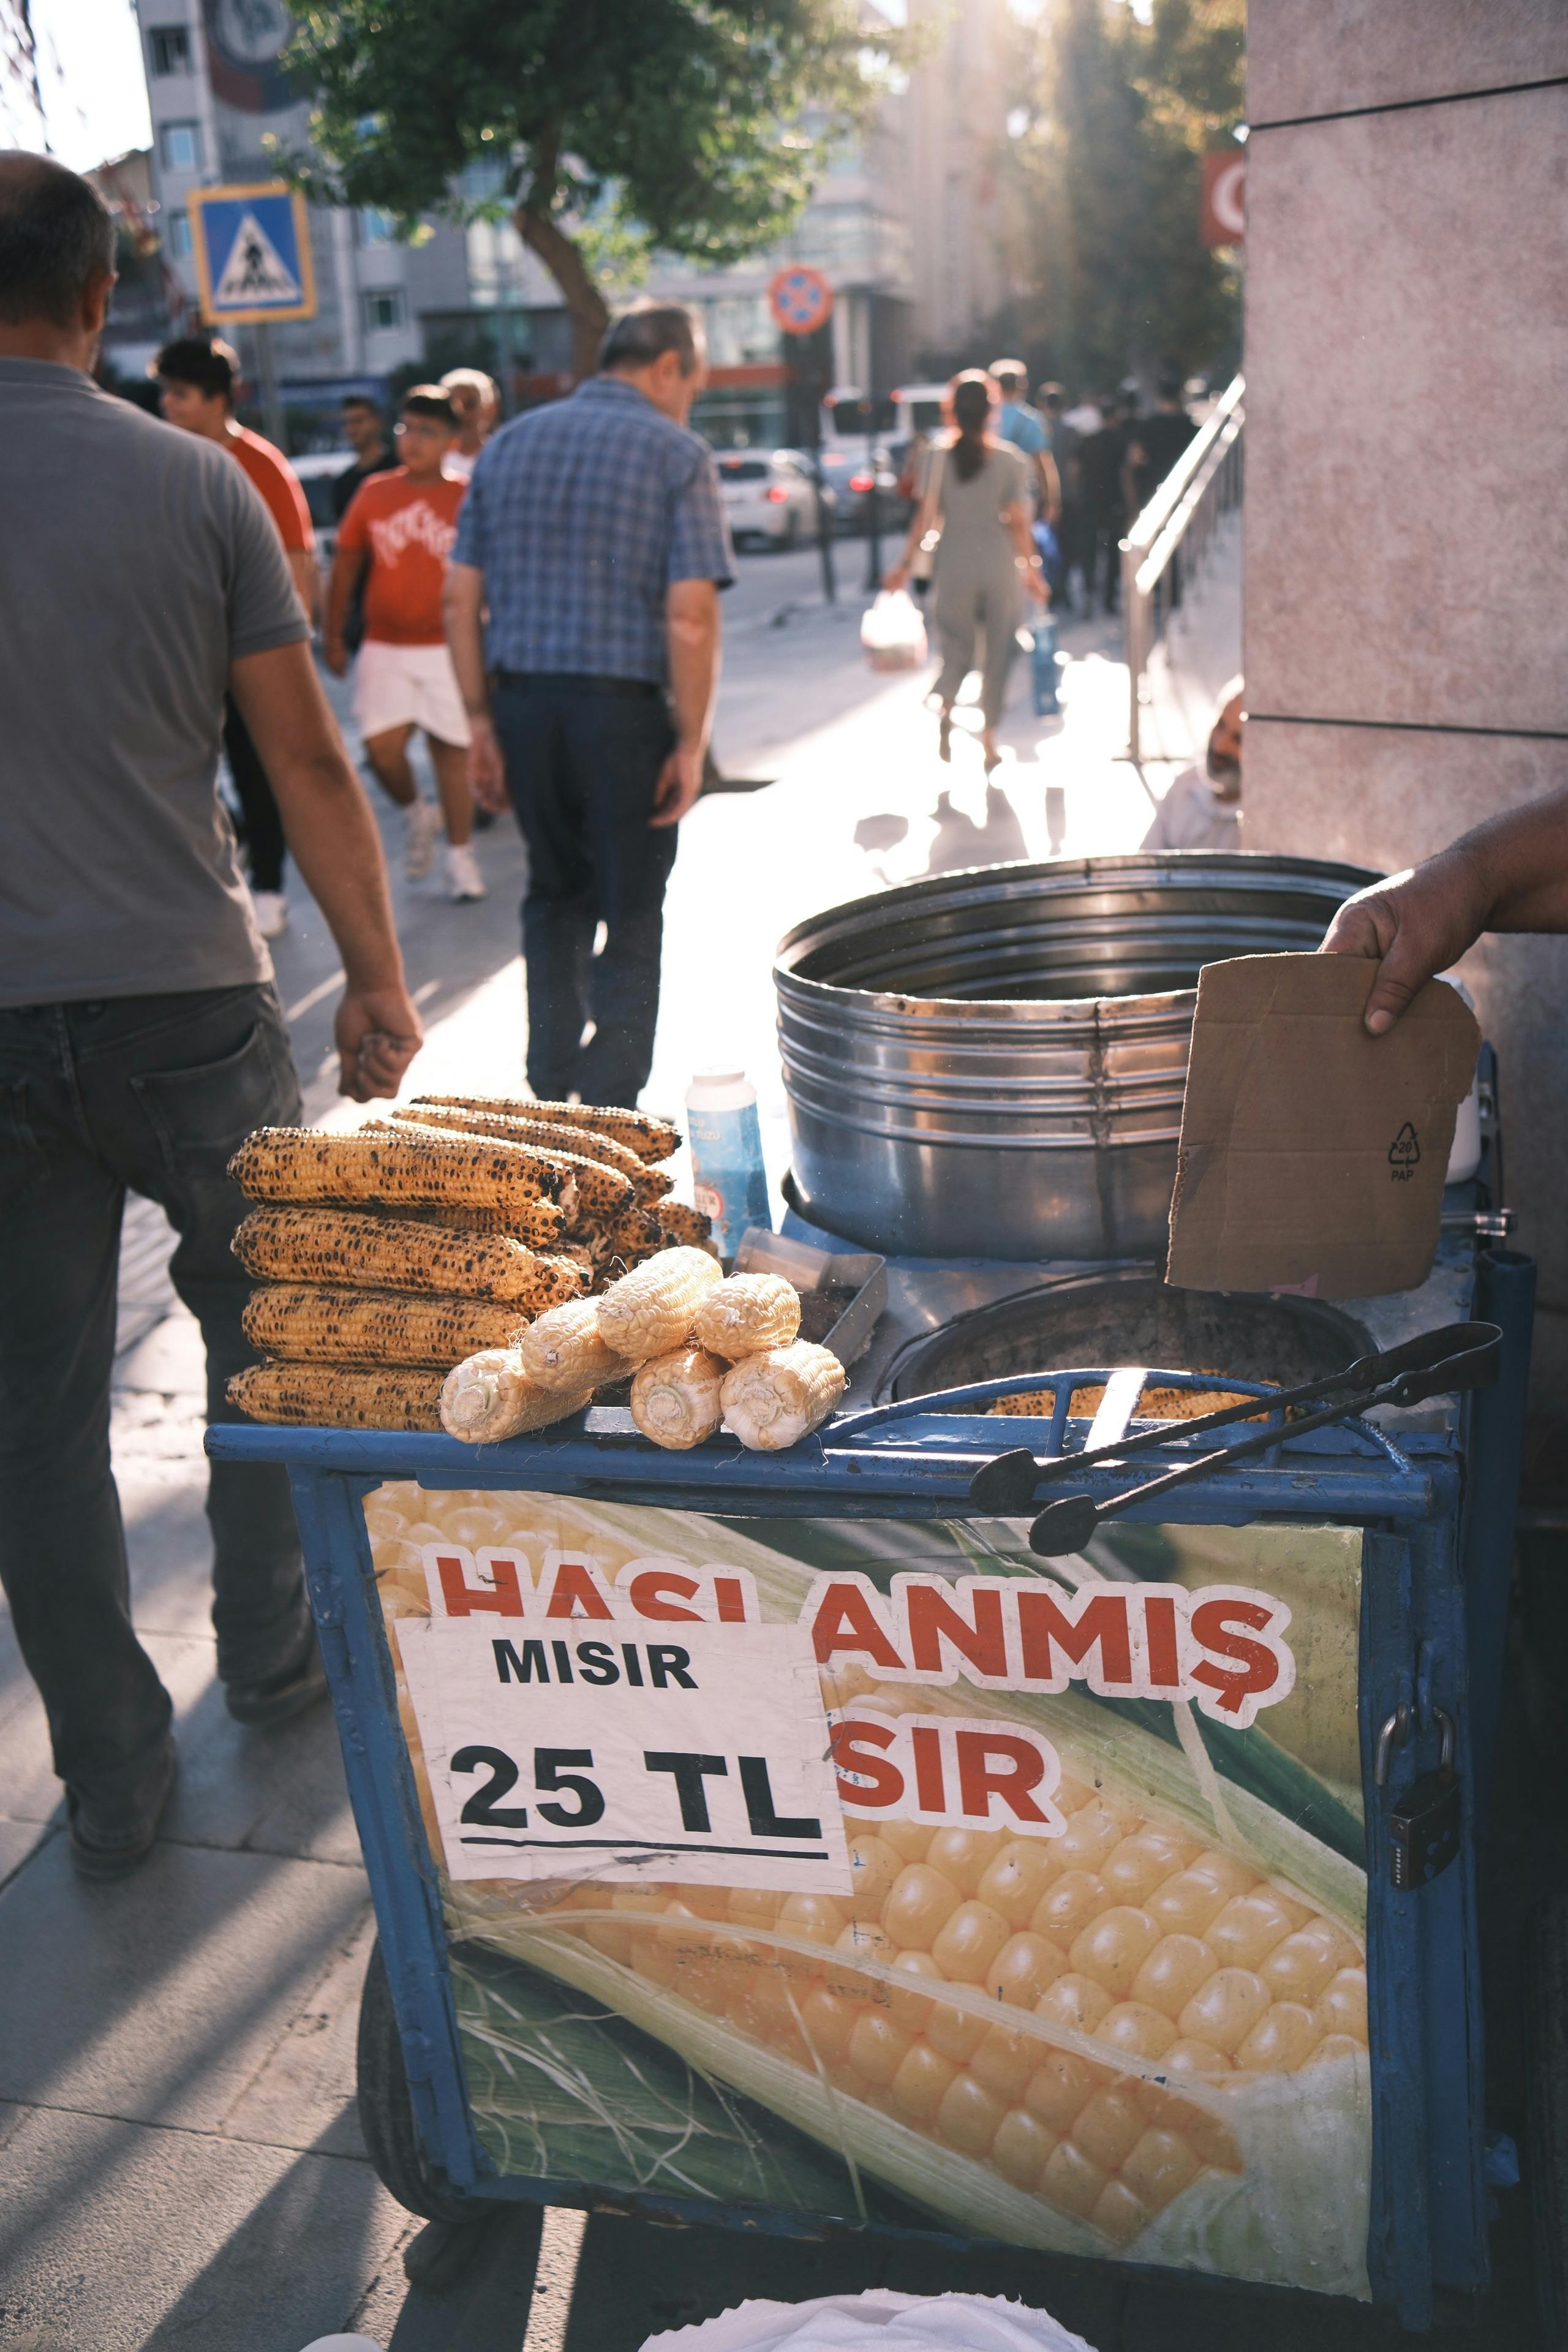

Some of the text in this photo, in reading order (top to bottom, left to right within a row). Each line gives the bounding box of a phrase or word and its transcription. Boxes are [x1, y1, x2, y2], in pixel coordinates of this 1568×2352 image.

[1399, 1142, 1412, 1153] 20
[1391, 1170, 1414, 1182] PAP
[491, 1638, 699, 1690] MISIR
[450, 1745, 823, 1839] 25 TL
[829, 1720, 1052, 1824] SIR
